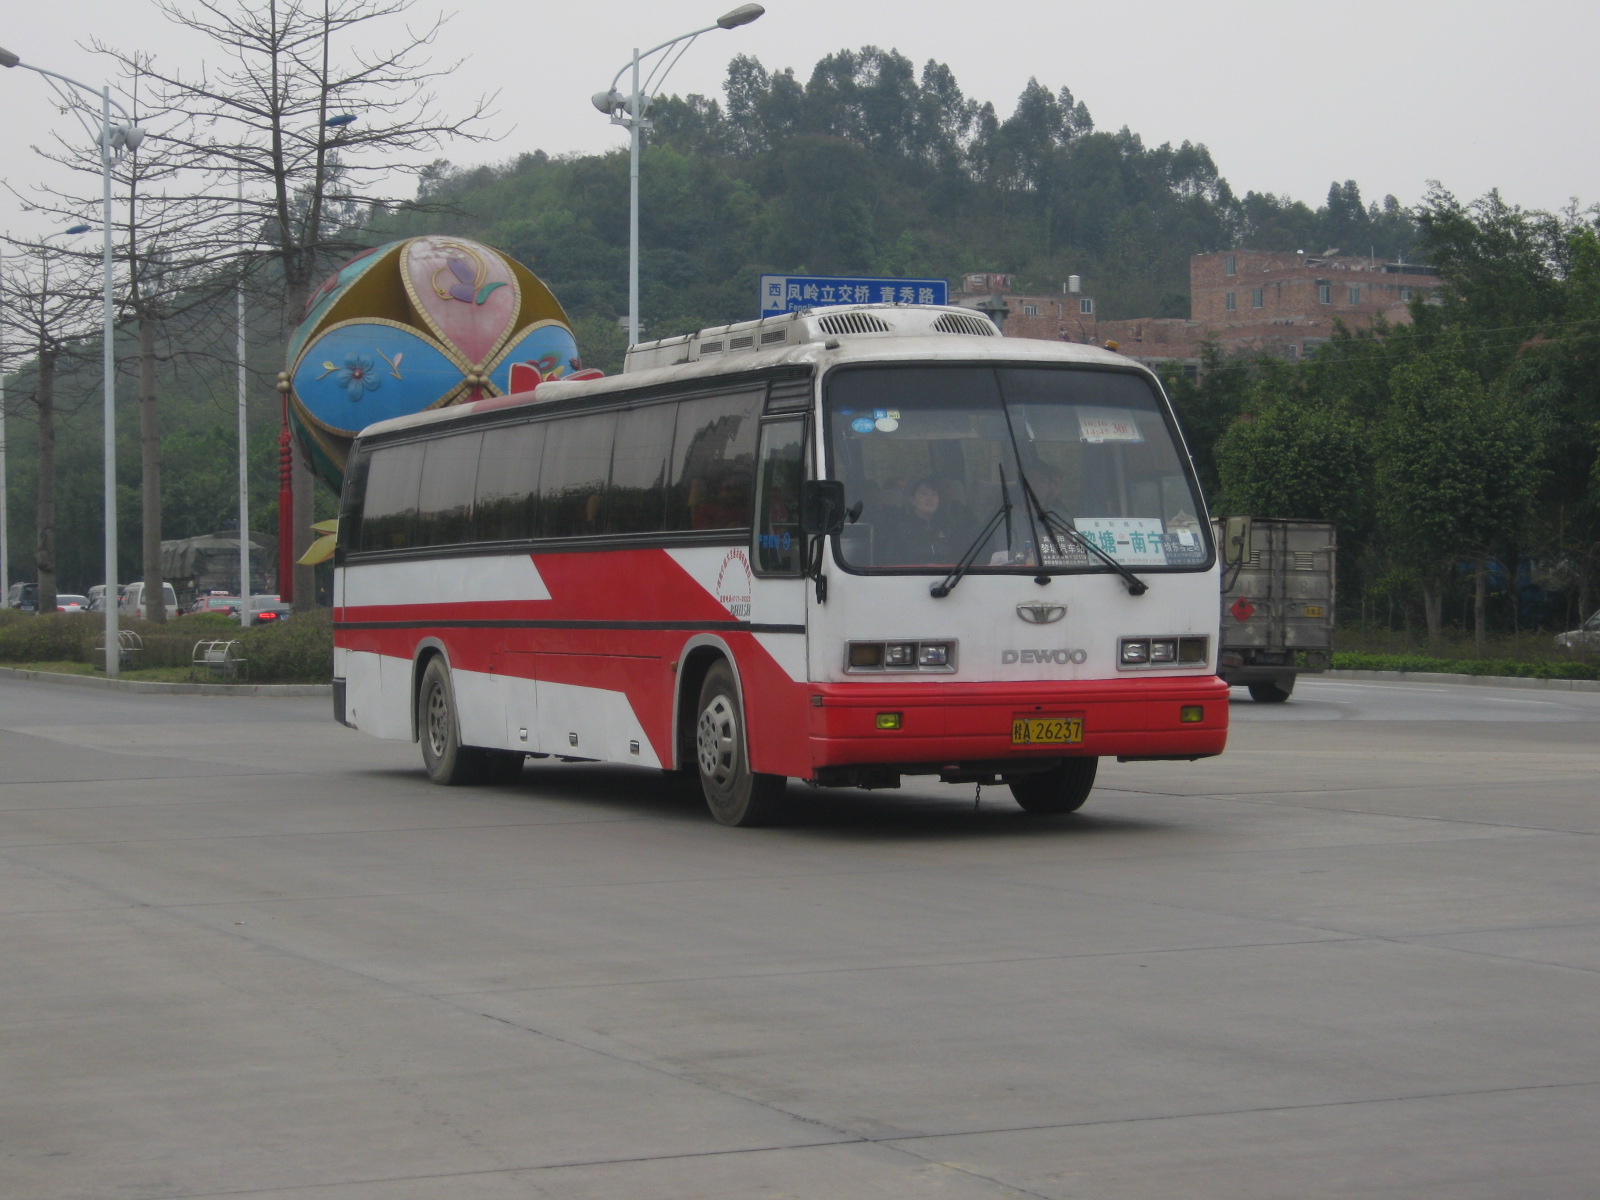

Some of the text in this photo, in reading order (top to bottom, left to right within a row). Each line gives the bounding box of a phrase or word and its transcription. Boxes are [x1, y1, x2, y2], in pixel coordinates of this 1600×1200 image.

[768, 283, 782, 297] 西
[786, 283, 935, 304] 凤岭立交桥 青秀路
